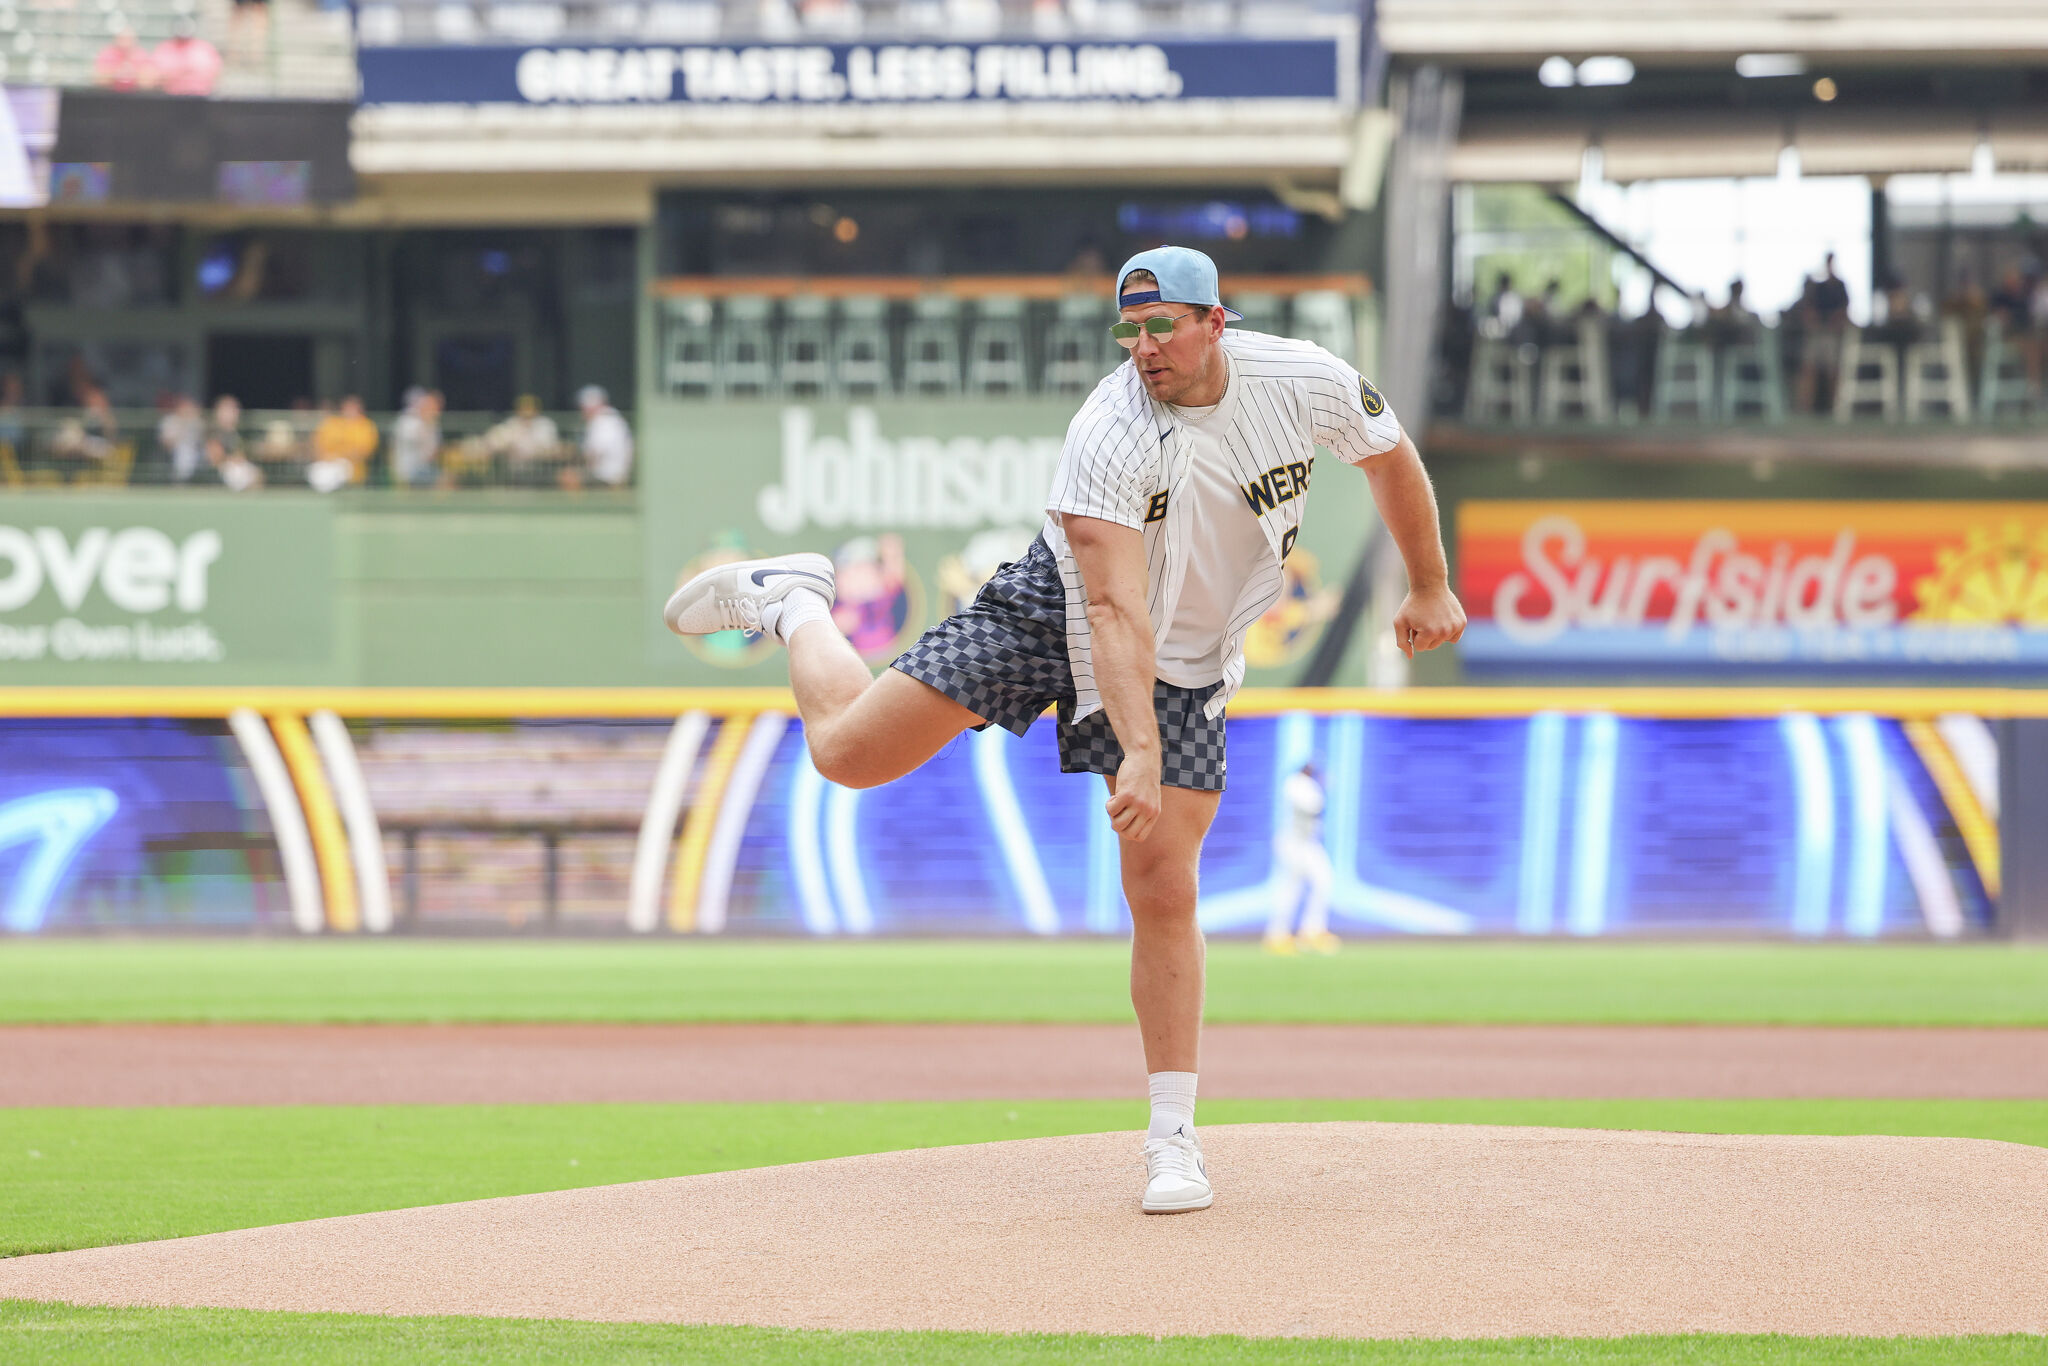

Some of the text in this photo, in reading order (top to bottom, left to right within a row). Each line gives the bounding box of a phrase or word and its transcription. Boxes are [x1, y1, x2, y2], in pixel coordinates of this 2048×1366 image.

[516, 48, 673, 102] GREAT
[848, 46, 972, 99] LESS
[1493, 515, 1897, 646] Surfside
